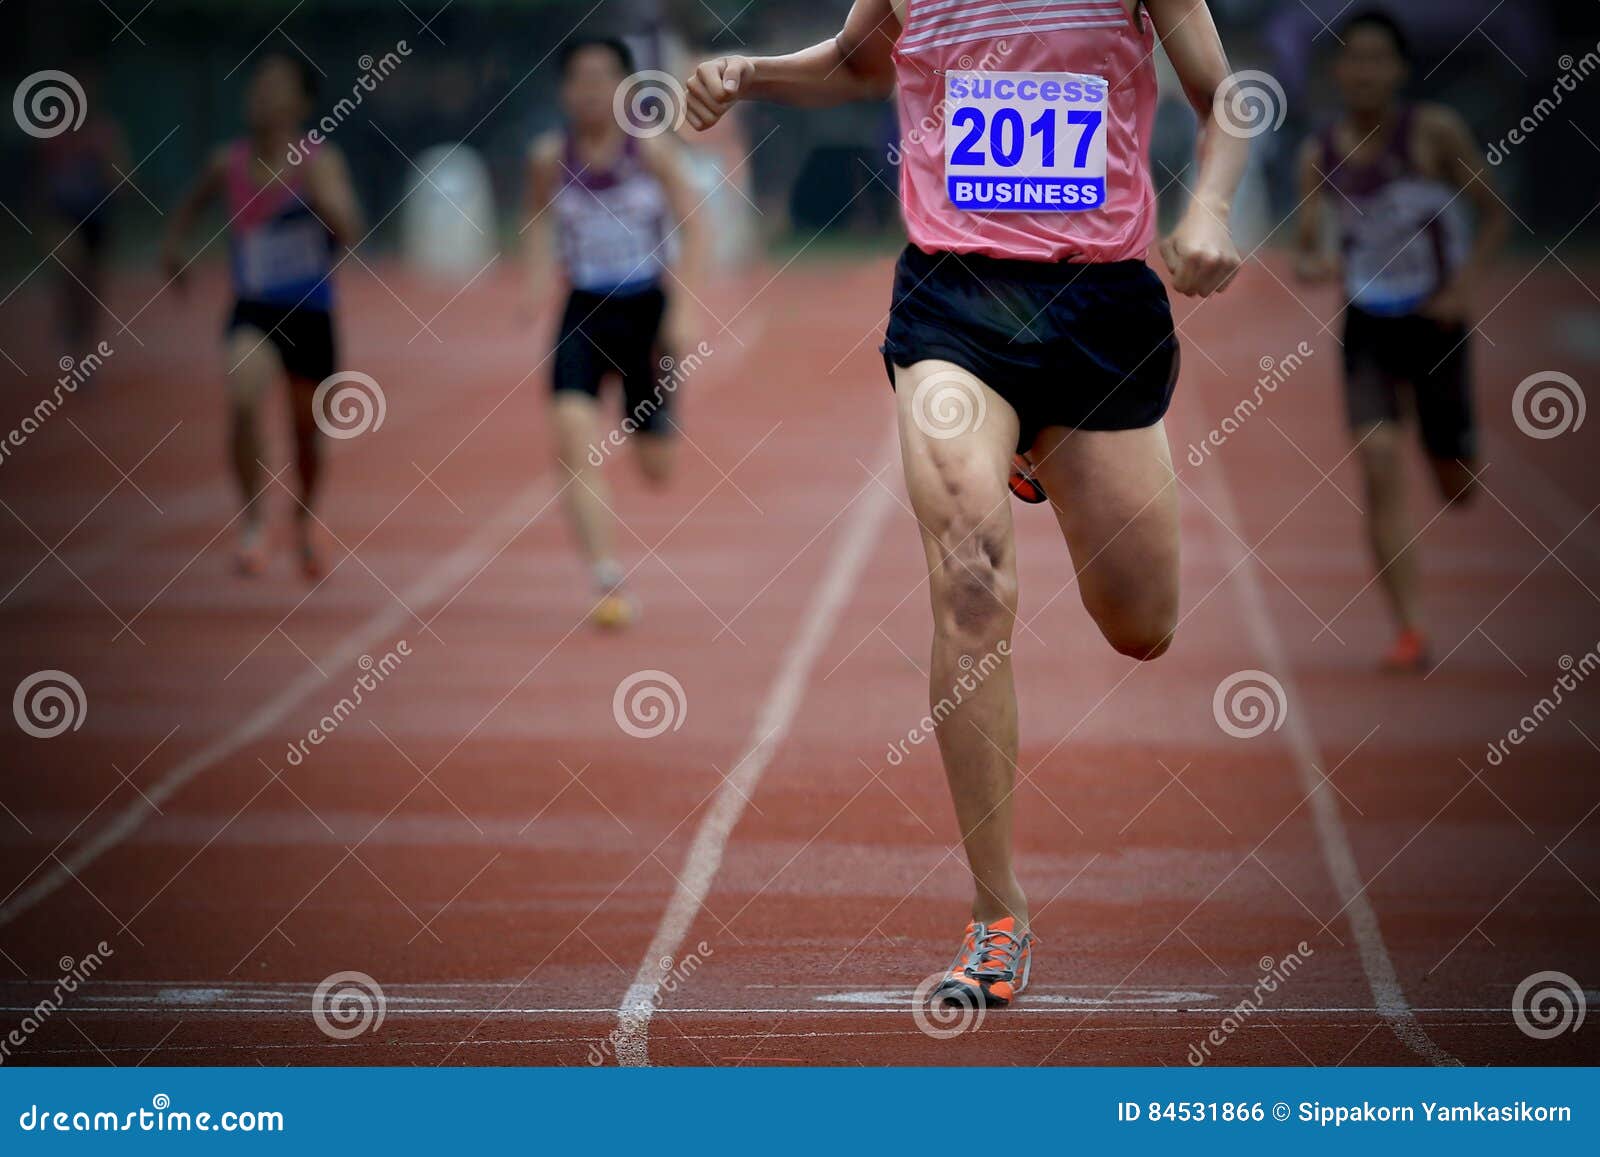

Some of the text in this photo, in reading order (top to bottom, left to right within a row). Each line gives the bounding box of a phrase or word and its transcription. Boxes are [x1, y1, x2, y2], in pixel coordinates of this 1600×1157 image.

[950, 78, 1104, 102] success
[950, 107, 1102, 168] 2017
[955, 182, 1098, 204] BUSINESS
